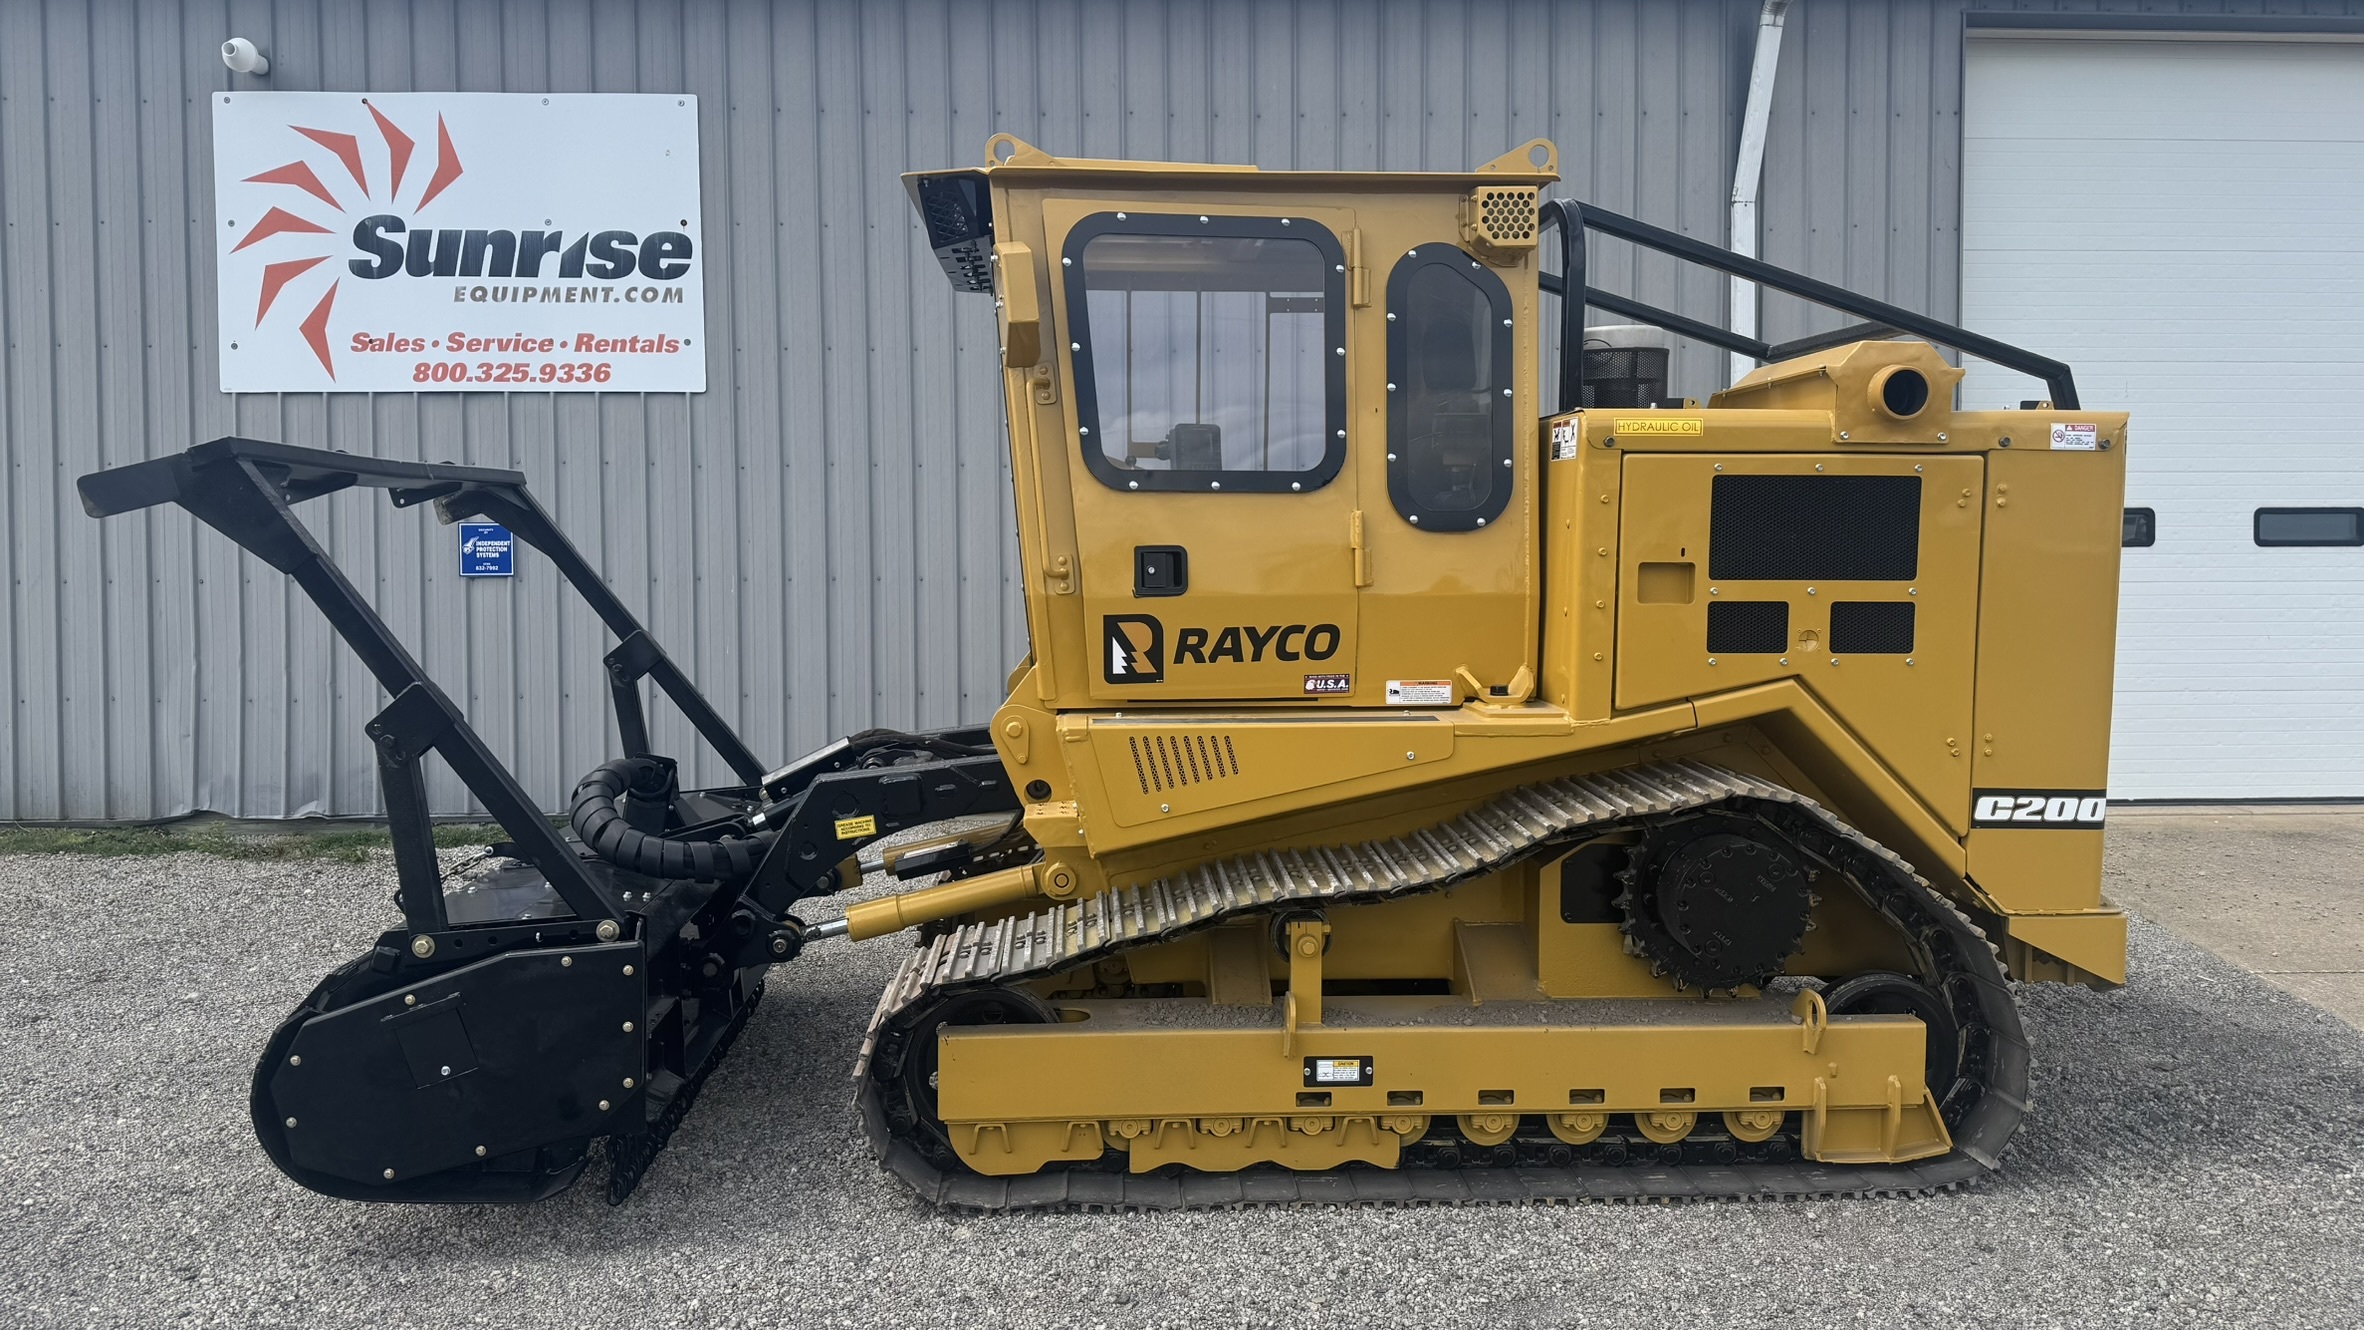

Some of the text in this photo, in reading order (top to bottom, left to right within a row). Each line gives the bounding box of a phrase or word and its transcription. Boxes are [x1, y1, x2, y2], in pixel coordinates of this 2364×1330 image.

[348, 214, 694, 280] Sunrise
[453, 285, 684, 304] EQUIPMENT.COM
[350, 332, 680, 354] Sales Service Rentals
[412, 362, 612, 384] 800.325.9336
[1618, 421, 1699, 432] HYDRAULIC OIL
[1173, 623, 1341, 665] RAYCO
[1316, 679, 1349, 689] U.S.A.
[1974, 797, 2106, 821] C200
